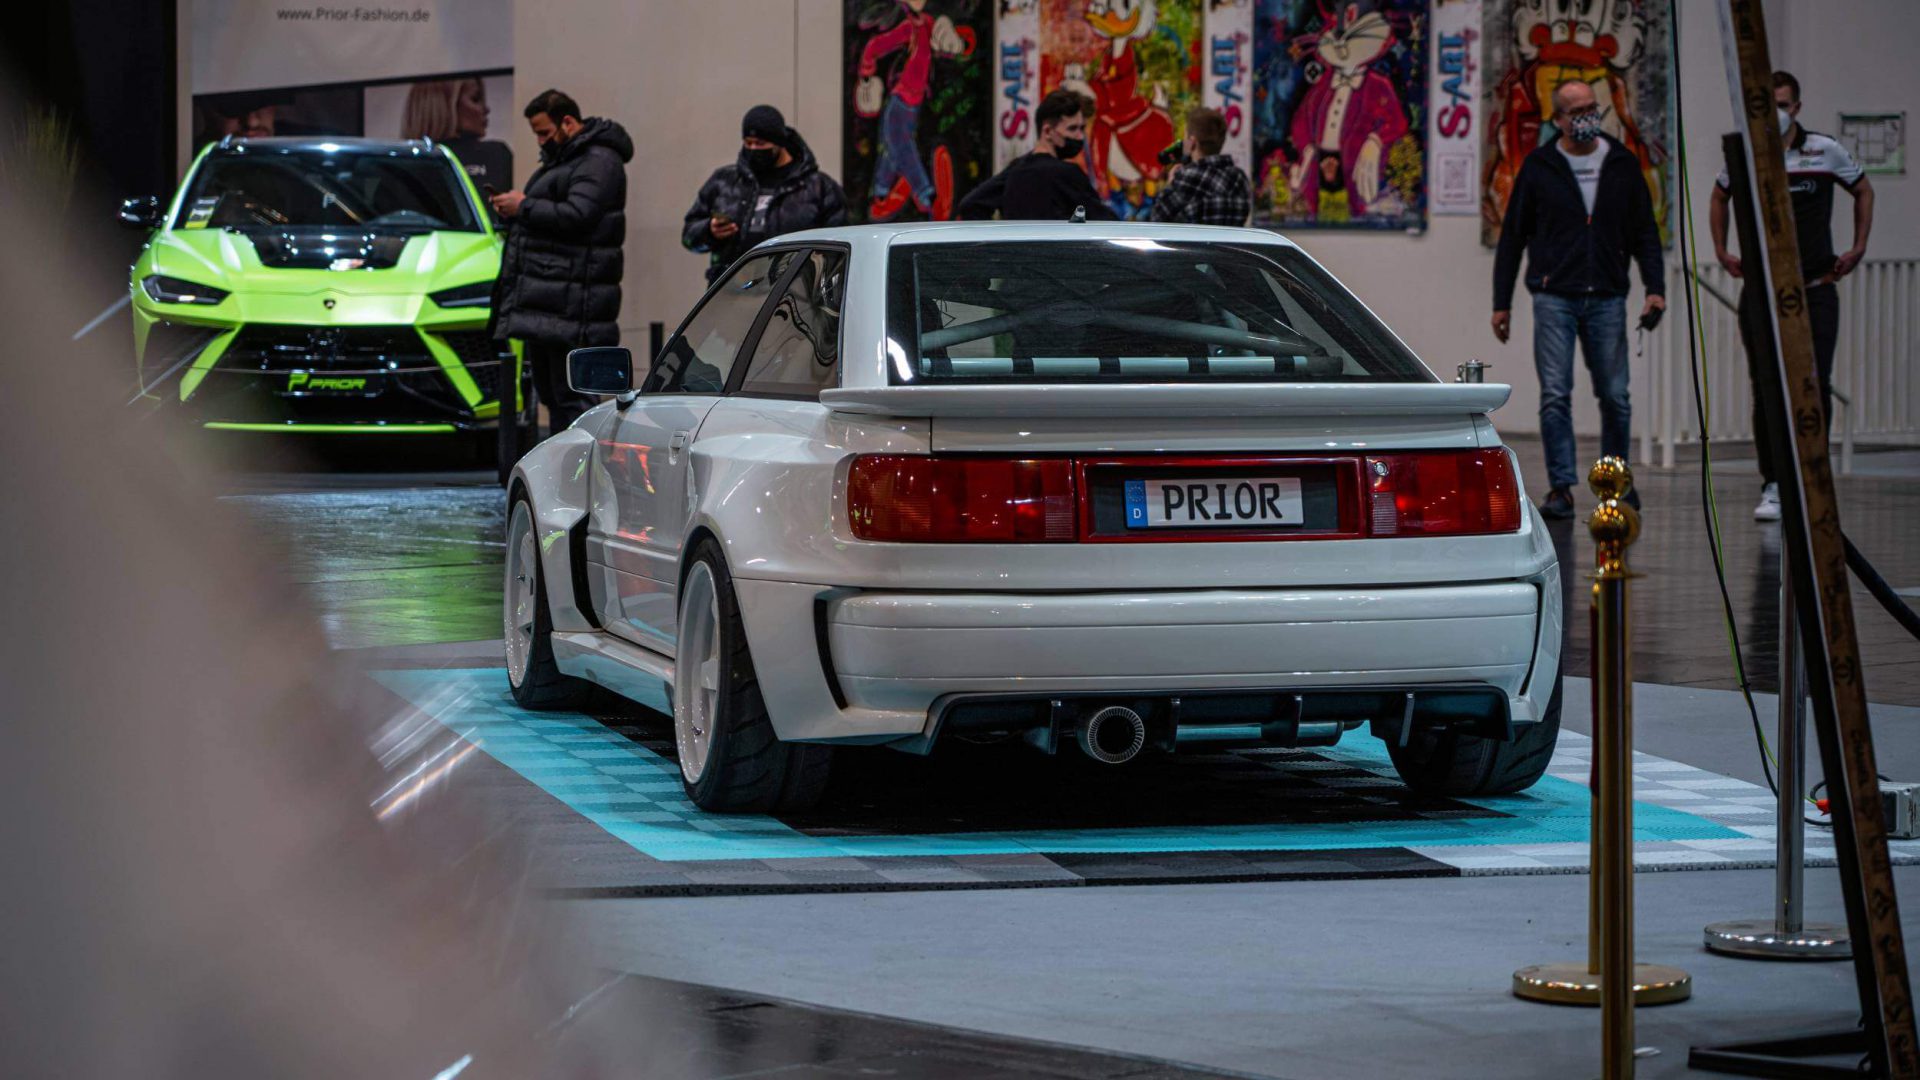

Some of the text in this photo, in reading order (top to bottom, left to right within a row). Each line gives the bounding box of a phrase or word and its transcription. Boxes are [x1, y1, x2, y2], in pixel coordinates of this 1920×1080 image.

[277, 7, 431, 22] www.Prior-Fashion.de
[1000, 40, 1030, 140] S-ART
[1438, 31, 1472, 138] S-ART
[308, 379, 366, 389] PRIOR
[1133, 482, 1283, 520] D PRIOR
